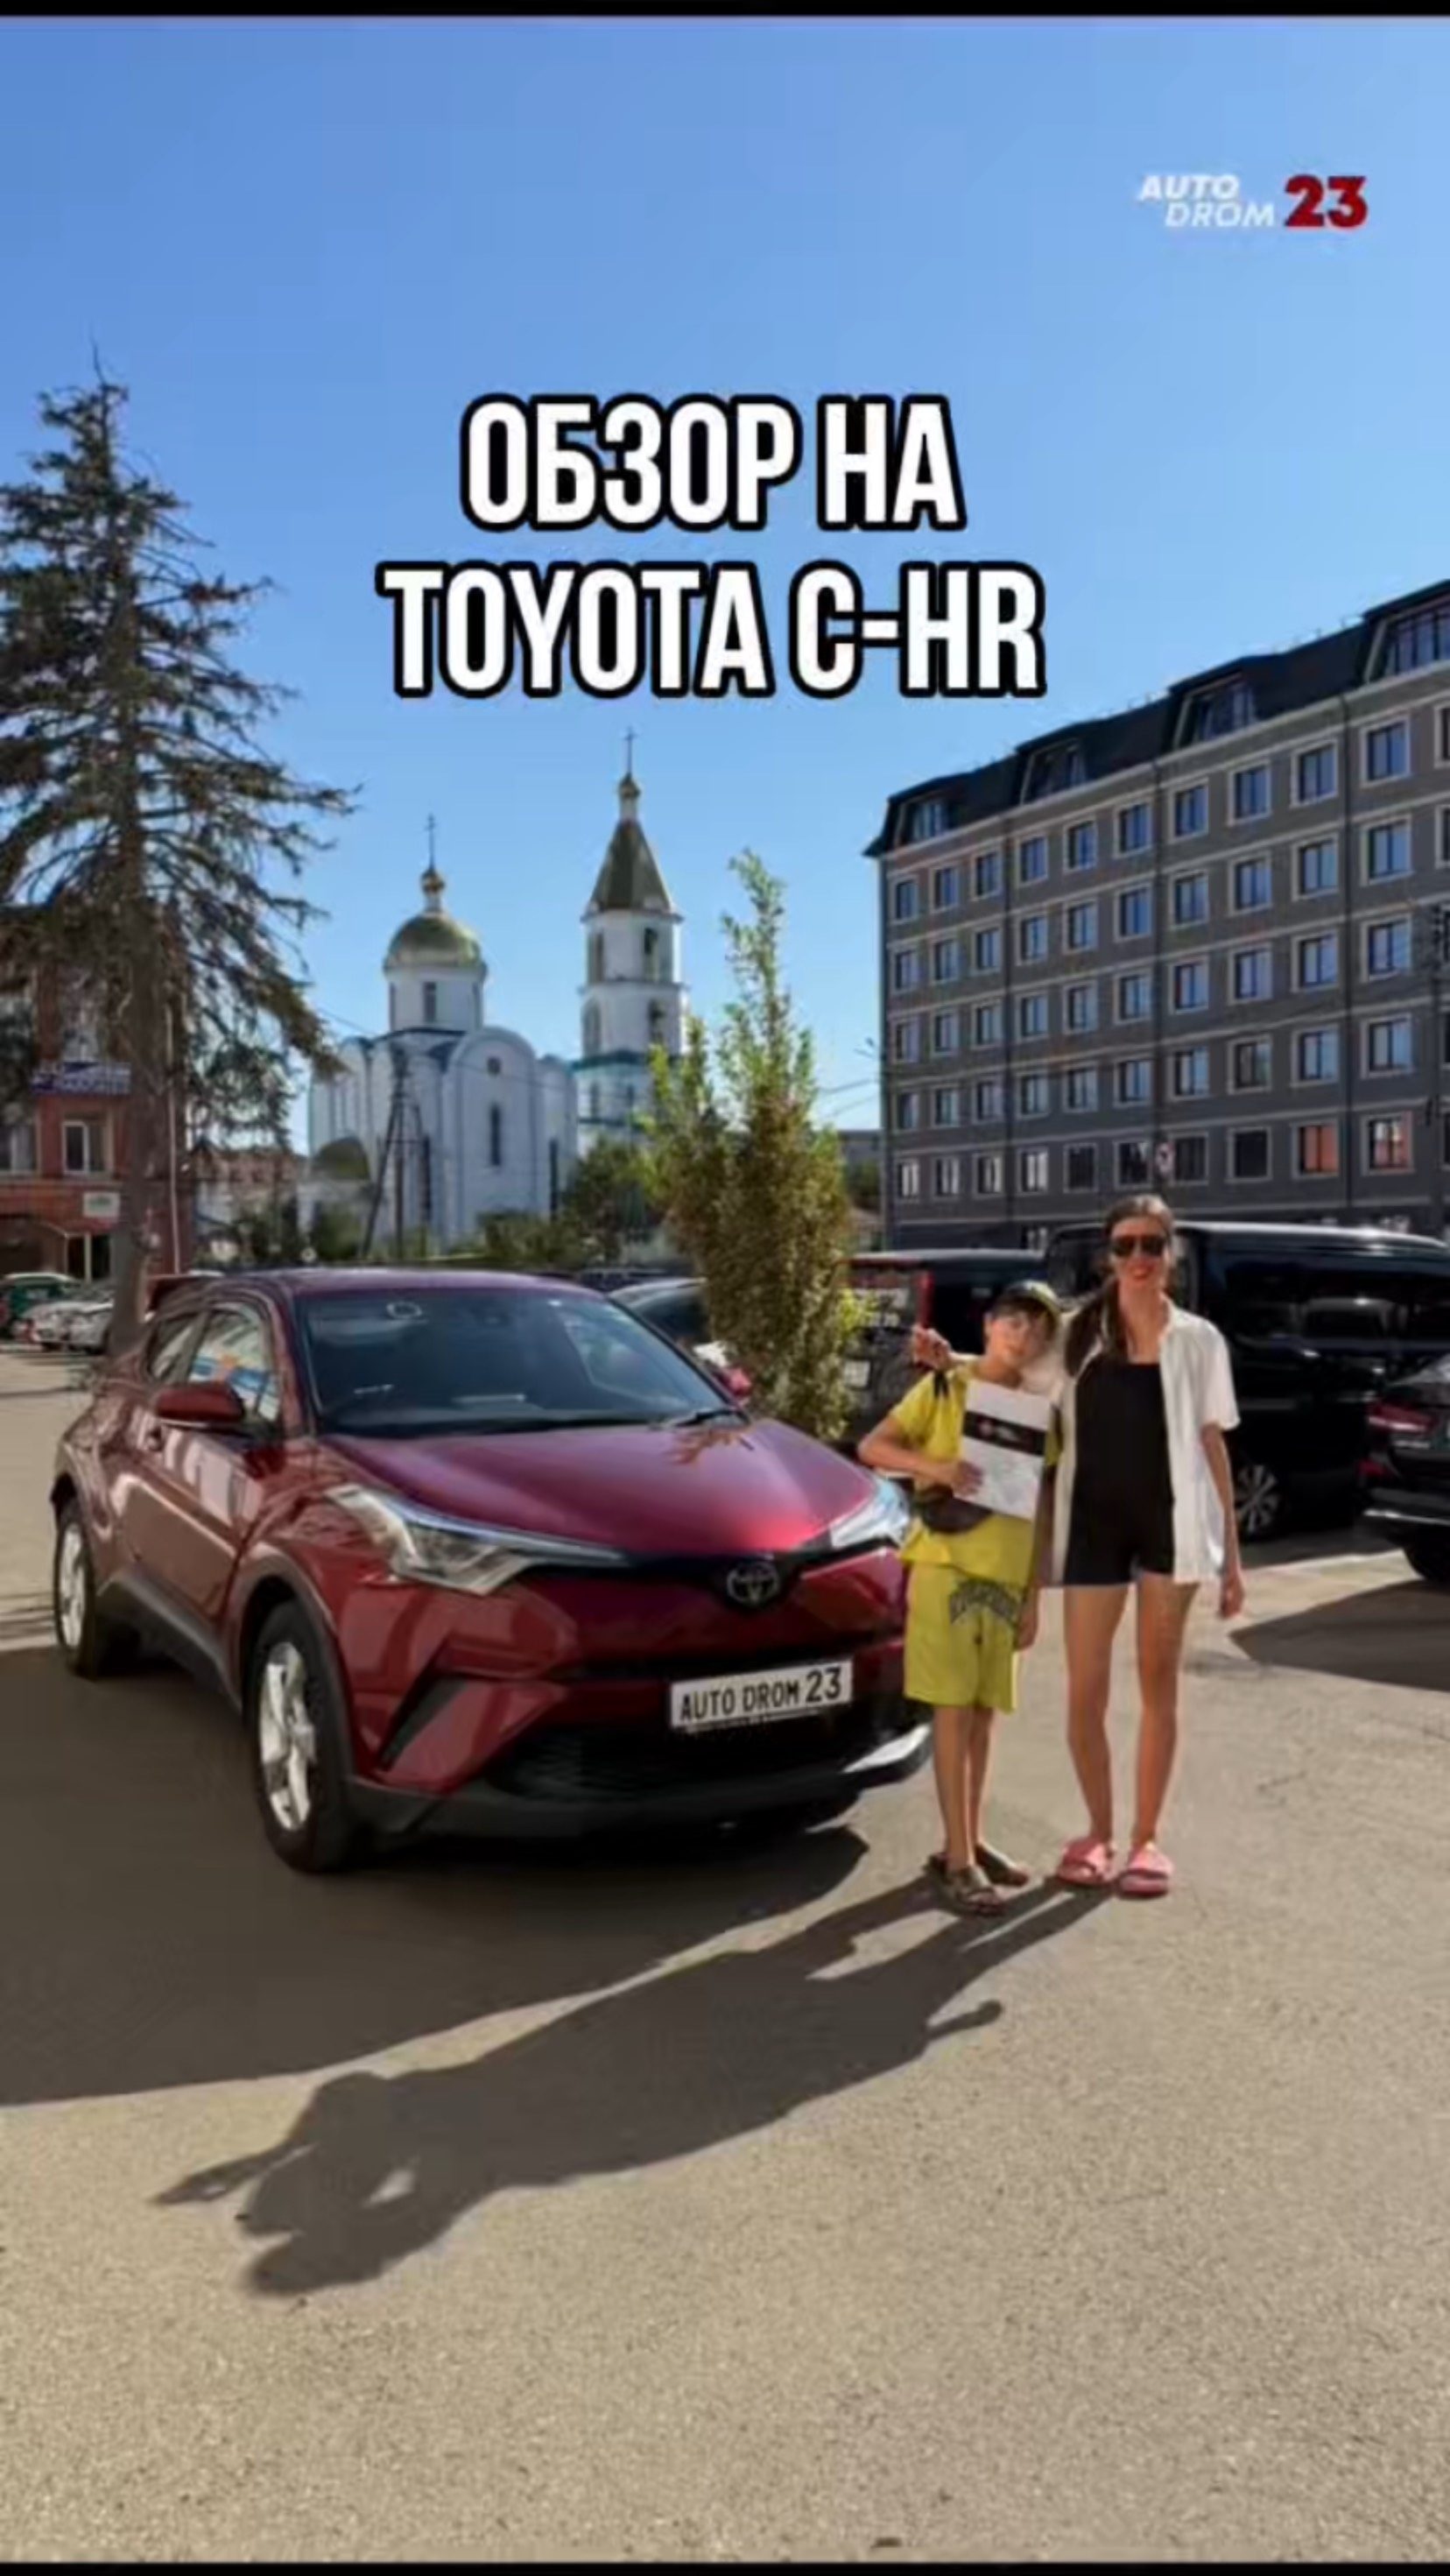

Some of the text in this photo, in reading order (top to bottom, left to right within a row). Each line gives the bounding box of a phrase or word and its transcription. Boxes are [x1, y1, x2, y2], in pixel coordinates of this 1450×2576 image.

[679, 1666, 841, 1721] AUTO DROM 23
